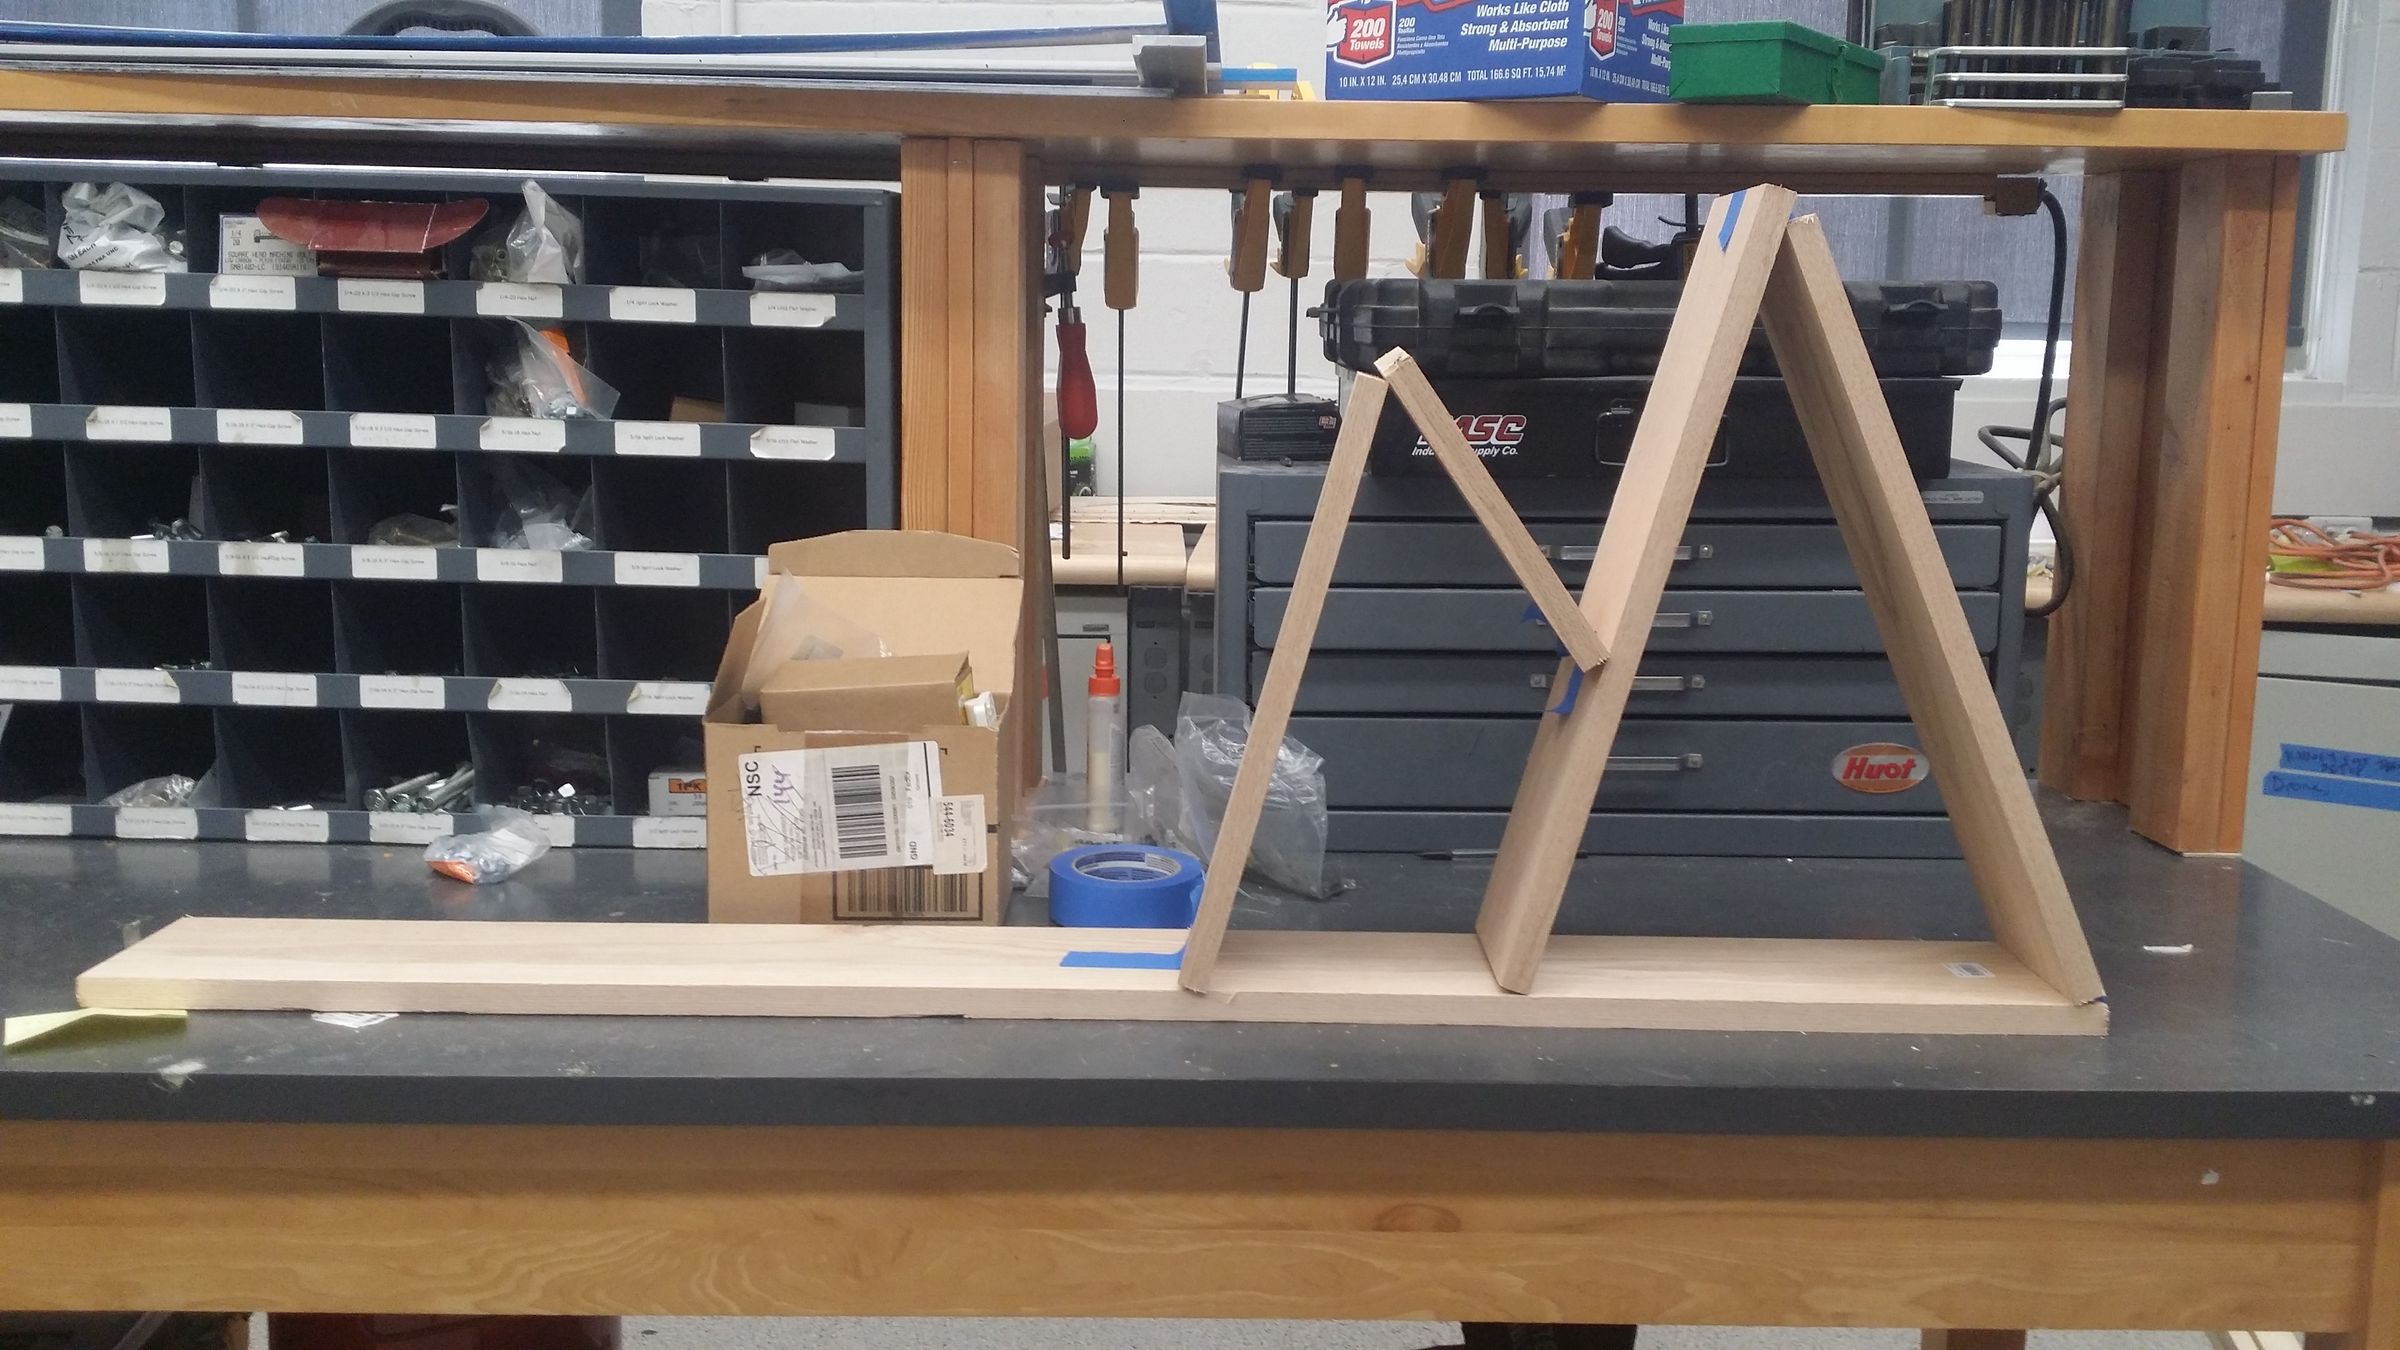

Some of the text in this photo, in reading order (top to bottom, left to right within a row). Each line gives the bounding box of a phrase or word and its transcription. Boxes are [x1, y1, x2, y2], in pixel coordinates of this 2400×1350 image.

[1476, 0, 1570, 17] Works Like Cloth
[1350, 18, 1386, 38] 200
[1398, 17, 1416, 28] 200
[1460, 17, 1570, 36] Strong & Absorbent
[1598, 8, 1614, 30] 200
[1350, 38, 1385, 51] Towels
[1488, 37, 1568, 51] Multi-Purpose
[1339, 77, 1348, 88] 10
[1349, 76, 1359, 87] IN.
[1360, 77, 1367, 87] X
[1367, 76, 1376, 86] 12
[1377, 75, 1387, 86] IN.
[1392, 74, 1408, 86] 25,4
[1409, 73, 1421, 84] CM
[1421, 73, 1428, 84] X
[1428, 72, 1449, 84] 30,48
[1449, 72, 1462, 83] CM
[1467, 69, 1488, 81] TOTAL
[1490, 69, 1510, 80] 166.6
[1511, 68, 1522, 79] SQ
[1523, 67, 1533, 79] FT.
[1535, 66, 1555, 78] 15,74
[1473, 446, 1519, 458] upply Co.
[1842, 756, 1916, 779] Huot
[744, 760, 763, 797] NSC
